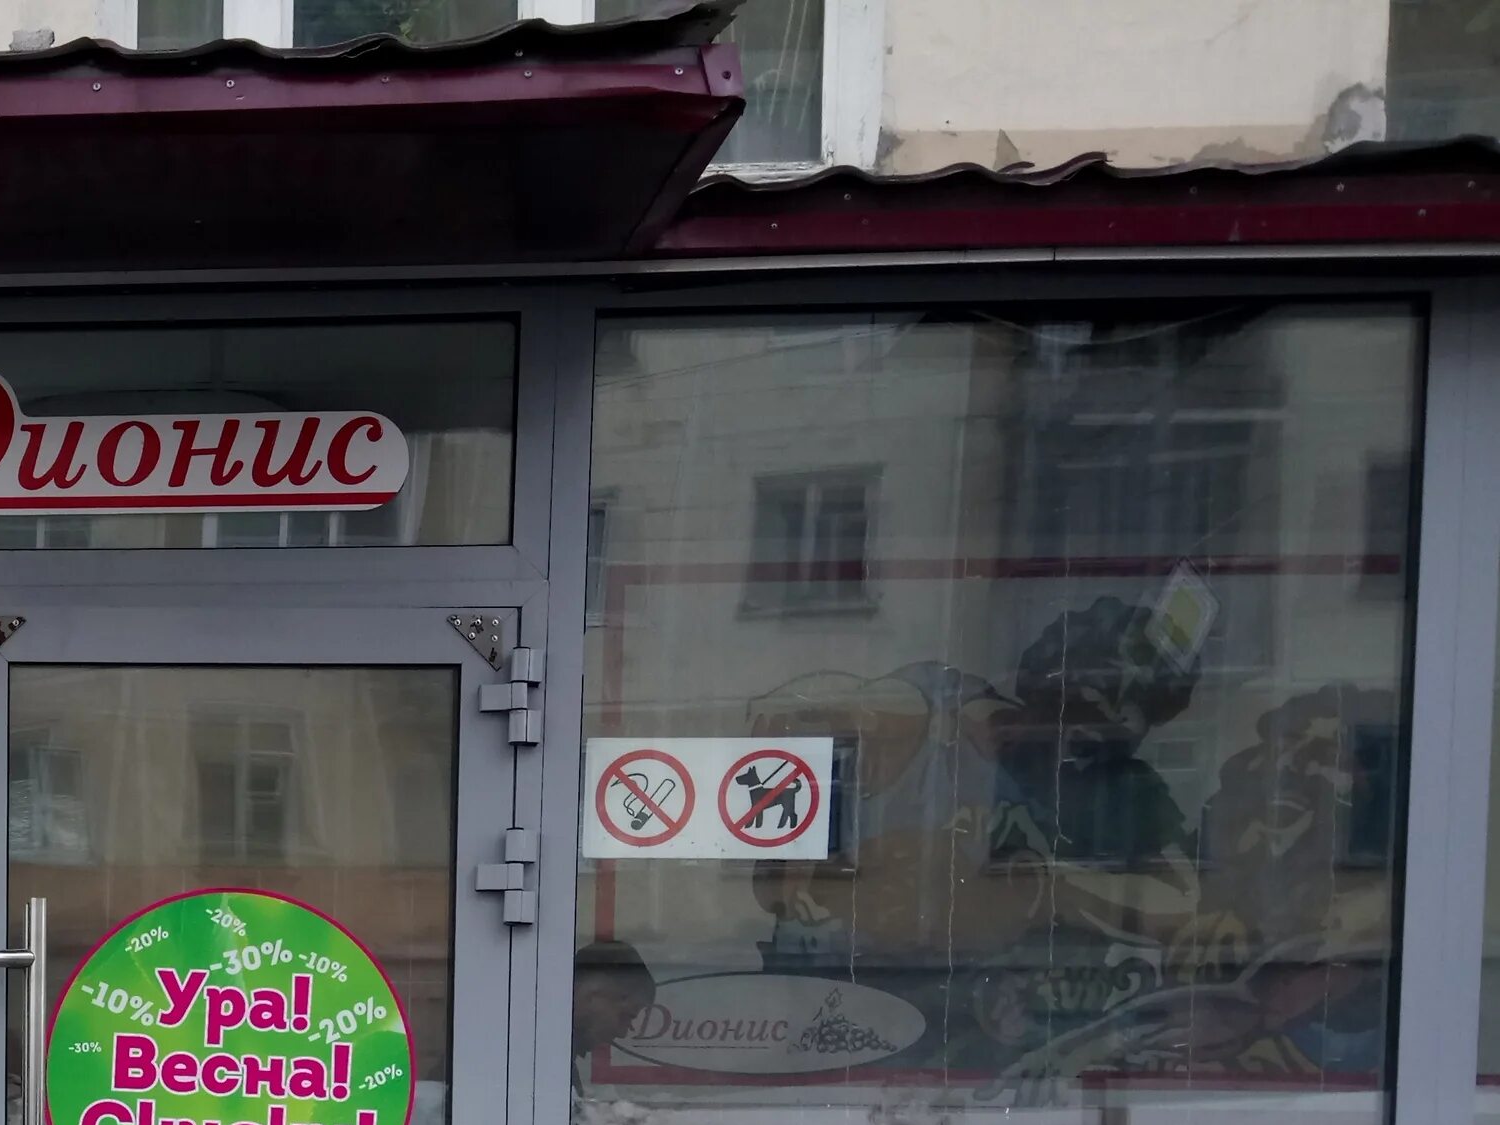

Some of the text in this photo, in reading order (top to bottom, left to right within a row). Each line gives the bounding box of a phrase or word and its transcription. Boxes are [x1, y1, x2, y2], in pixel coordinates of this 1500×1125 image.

[125, 926, 169, 953] -20%
[205, 907, 246, 937] -20%
[209, 939, 293, 975] -30%
[298, 952, 348, 982] -10%
[81, 981, 154, 1026] -10%
[155, 968, 314, 1047] Ура!
[308, 996, 387, 1043] -20%
[631, 1003, 789, 1043] Дионис
[68, 1041, 102, 1054] -30%
[111, 1033, 353, 1101] Весна!
[359, 1063, 403, 1091] -20%
